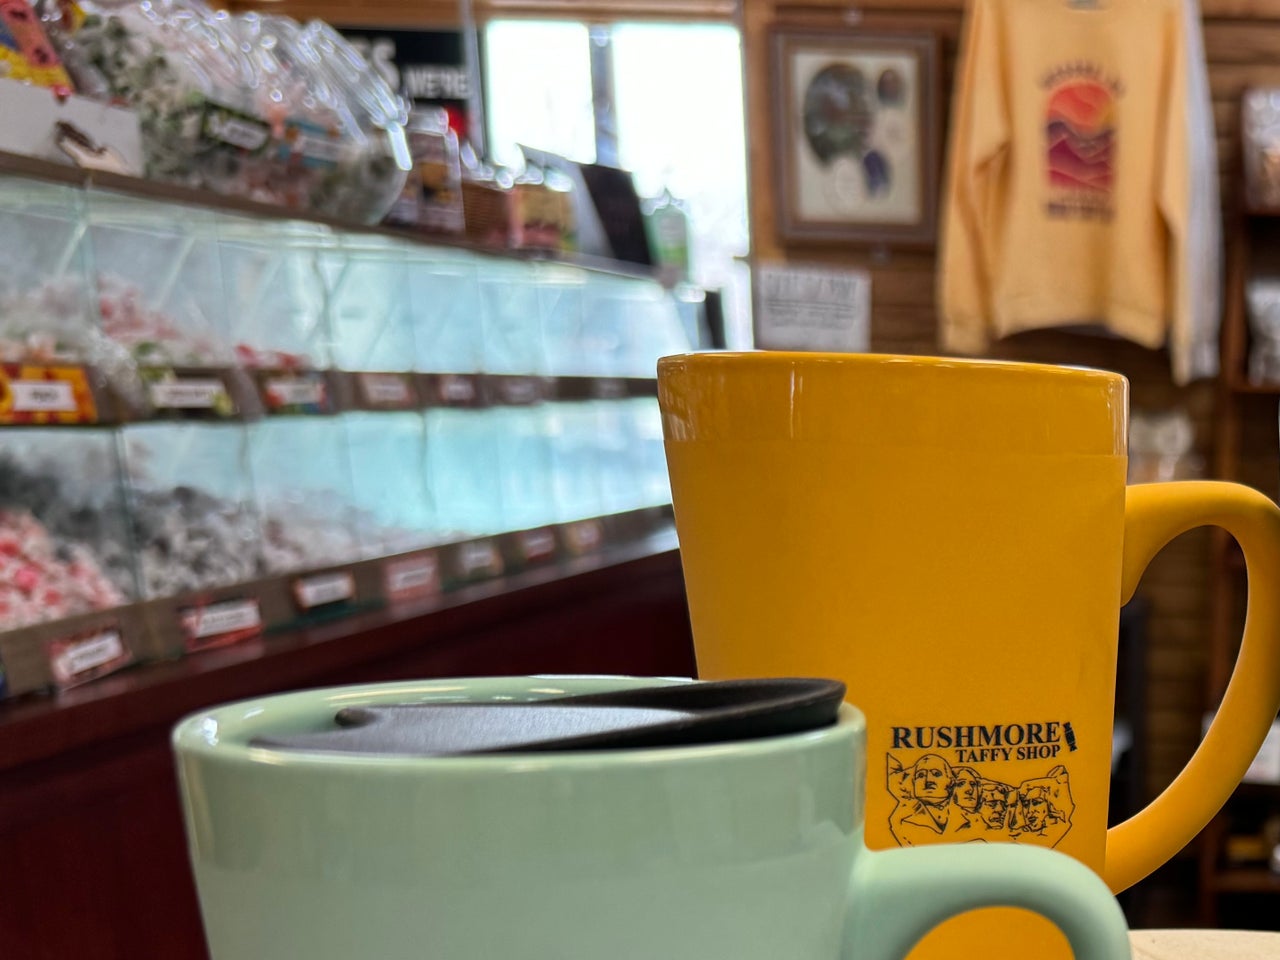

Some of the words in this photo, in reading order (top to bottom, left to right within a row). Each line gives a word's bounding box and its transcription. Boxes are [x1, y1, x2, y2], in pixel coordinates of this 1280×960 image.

[891, 721, 1061, 749] RUSHMORE
[955, 748, 1014, 763] TAFFY
[1016, 744, 1061, 761] SHOP
